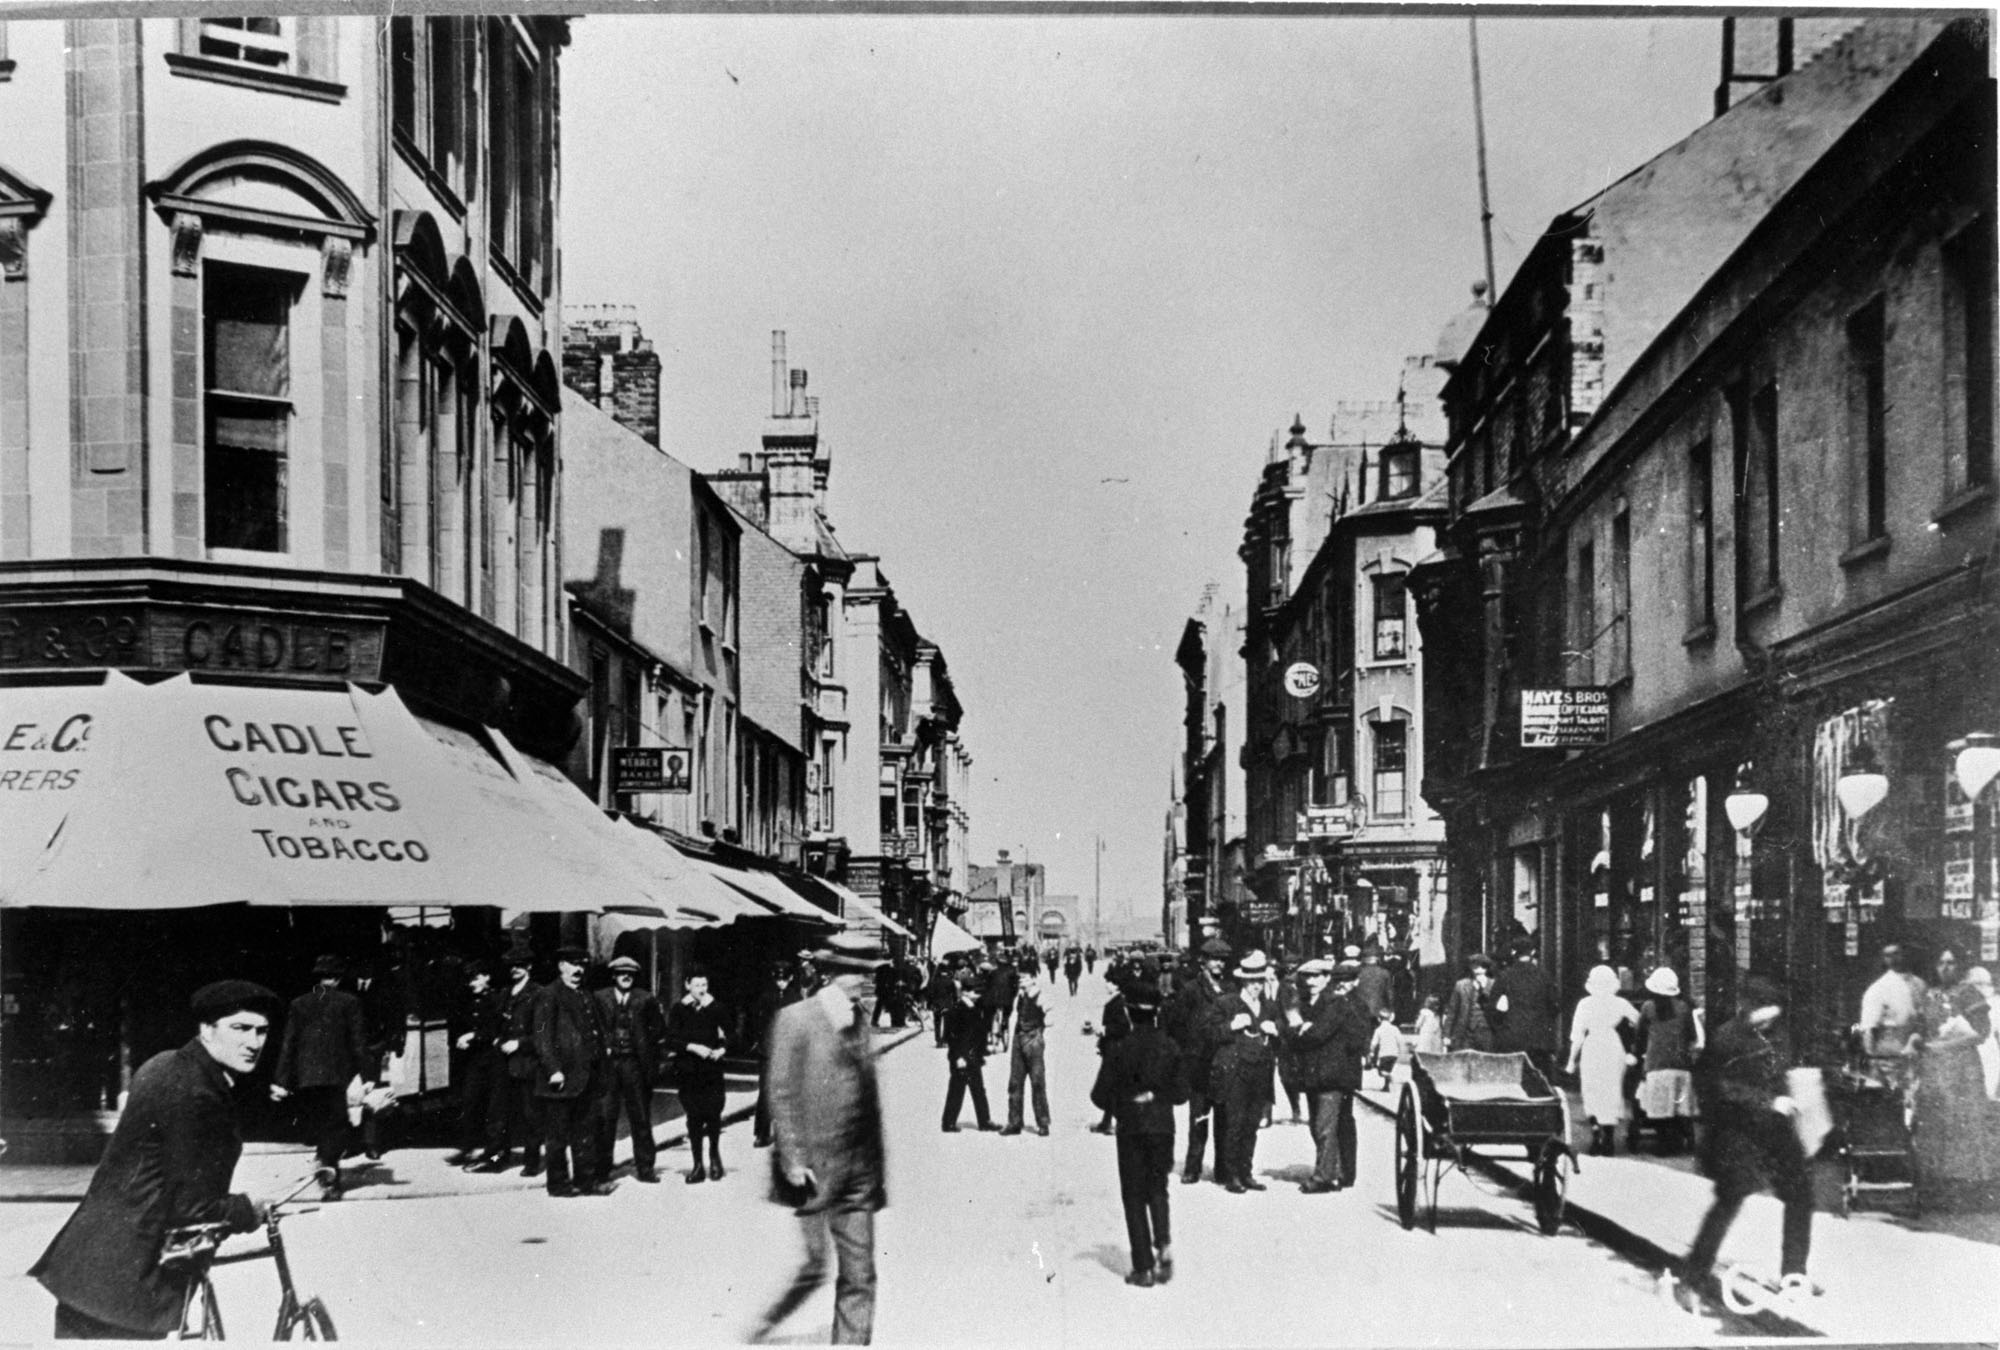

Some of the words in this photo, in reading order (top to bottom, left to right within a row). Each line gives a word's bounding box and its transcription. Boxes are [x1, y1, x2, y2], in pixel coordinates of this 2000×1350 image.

[183, 620, 351, 672] CADLE
[1522, 690, 1573, 704] HAYES
[204, 714, 373, 758] CADLE
[225, 767, 402, 812] CIGARS
[308, 818, 352, 829] AND
[252, 829, 430, 863] TOBACCO
